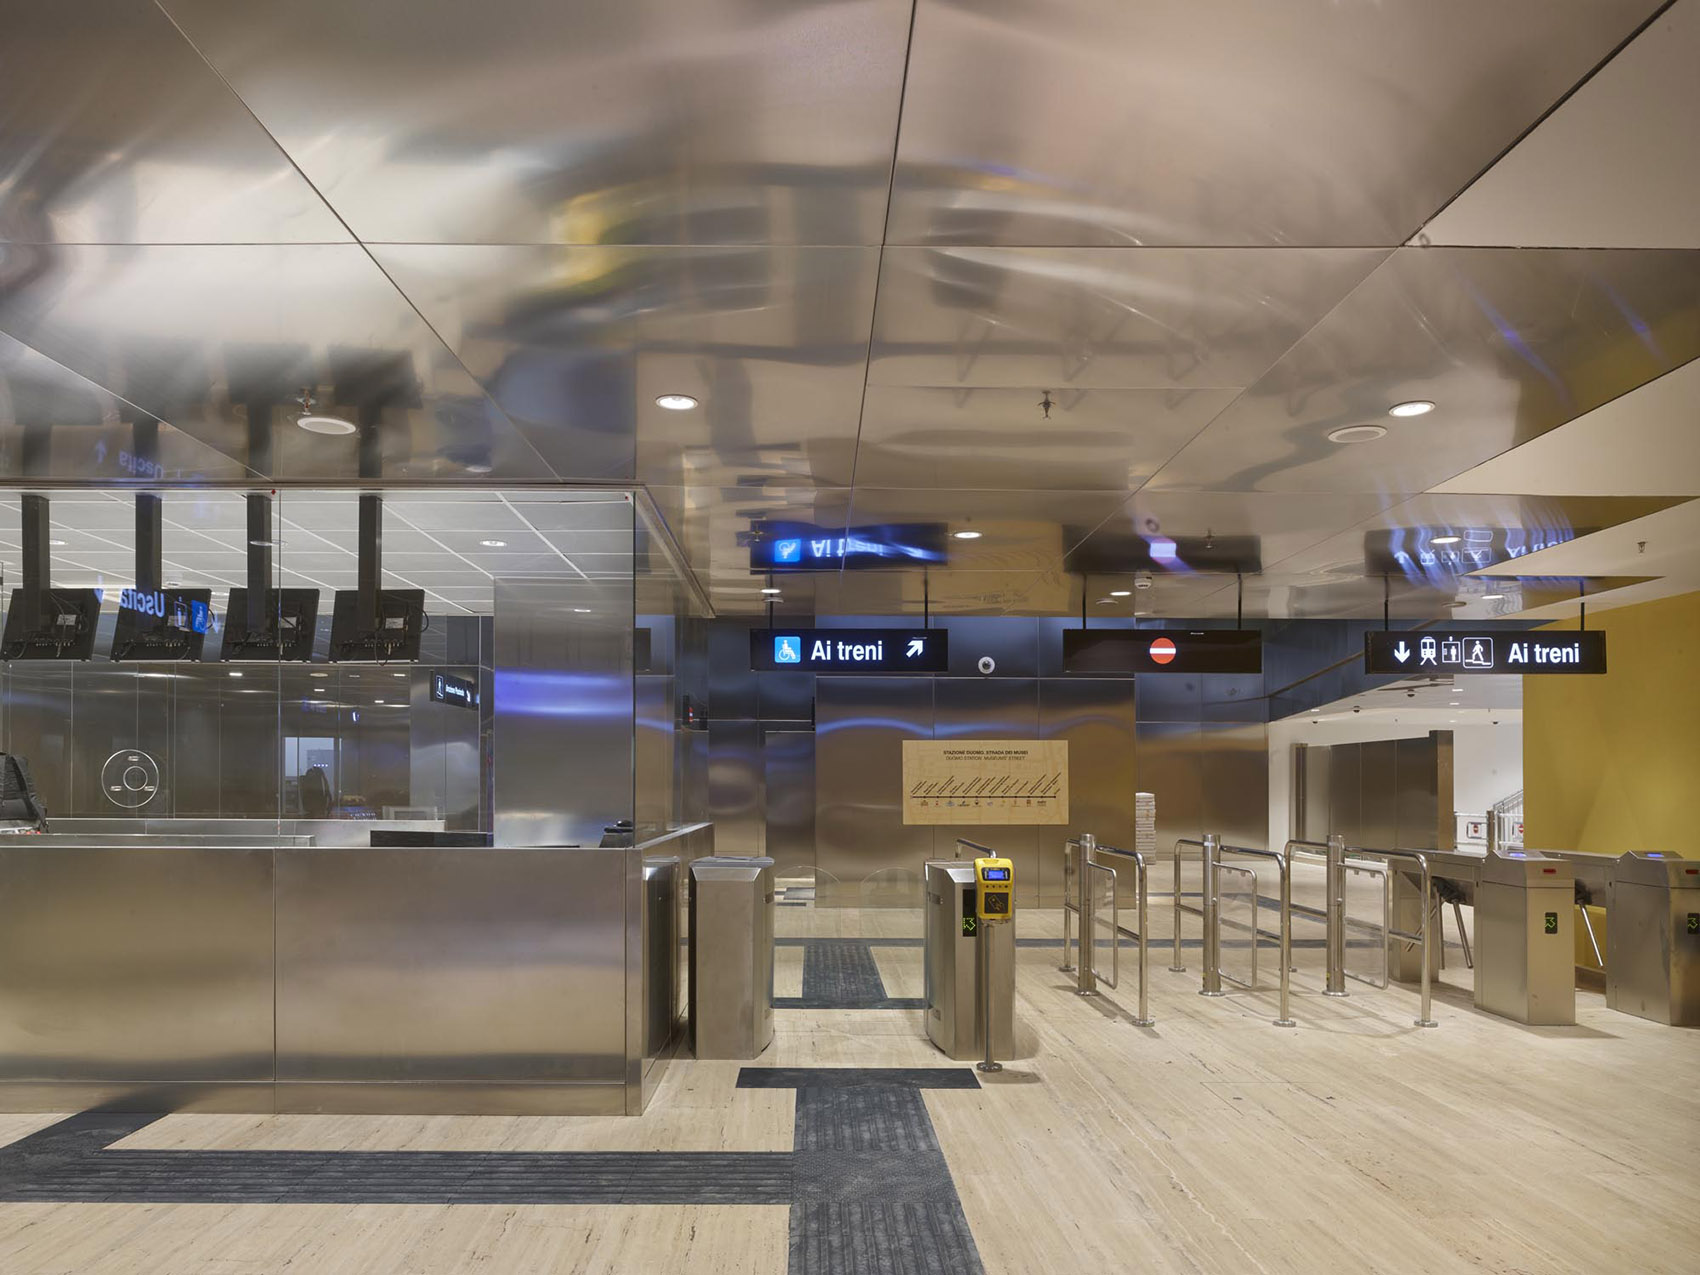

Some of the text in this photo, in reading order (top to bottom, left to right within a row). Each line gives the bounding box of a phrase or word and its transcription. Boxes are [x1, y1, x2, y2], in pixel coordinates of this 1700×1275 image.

[811, 640, 883, 661] Ai treni
[1508, 643, 1580, 664] Ai treni
